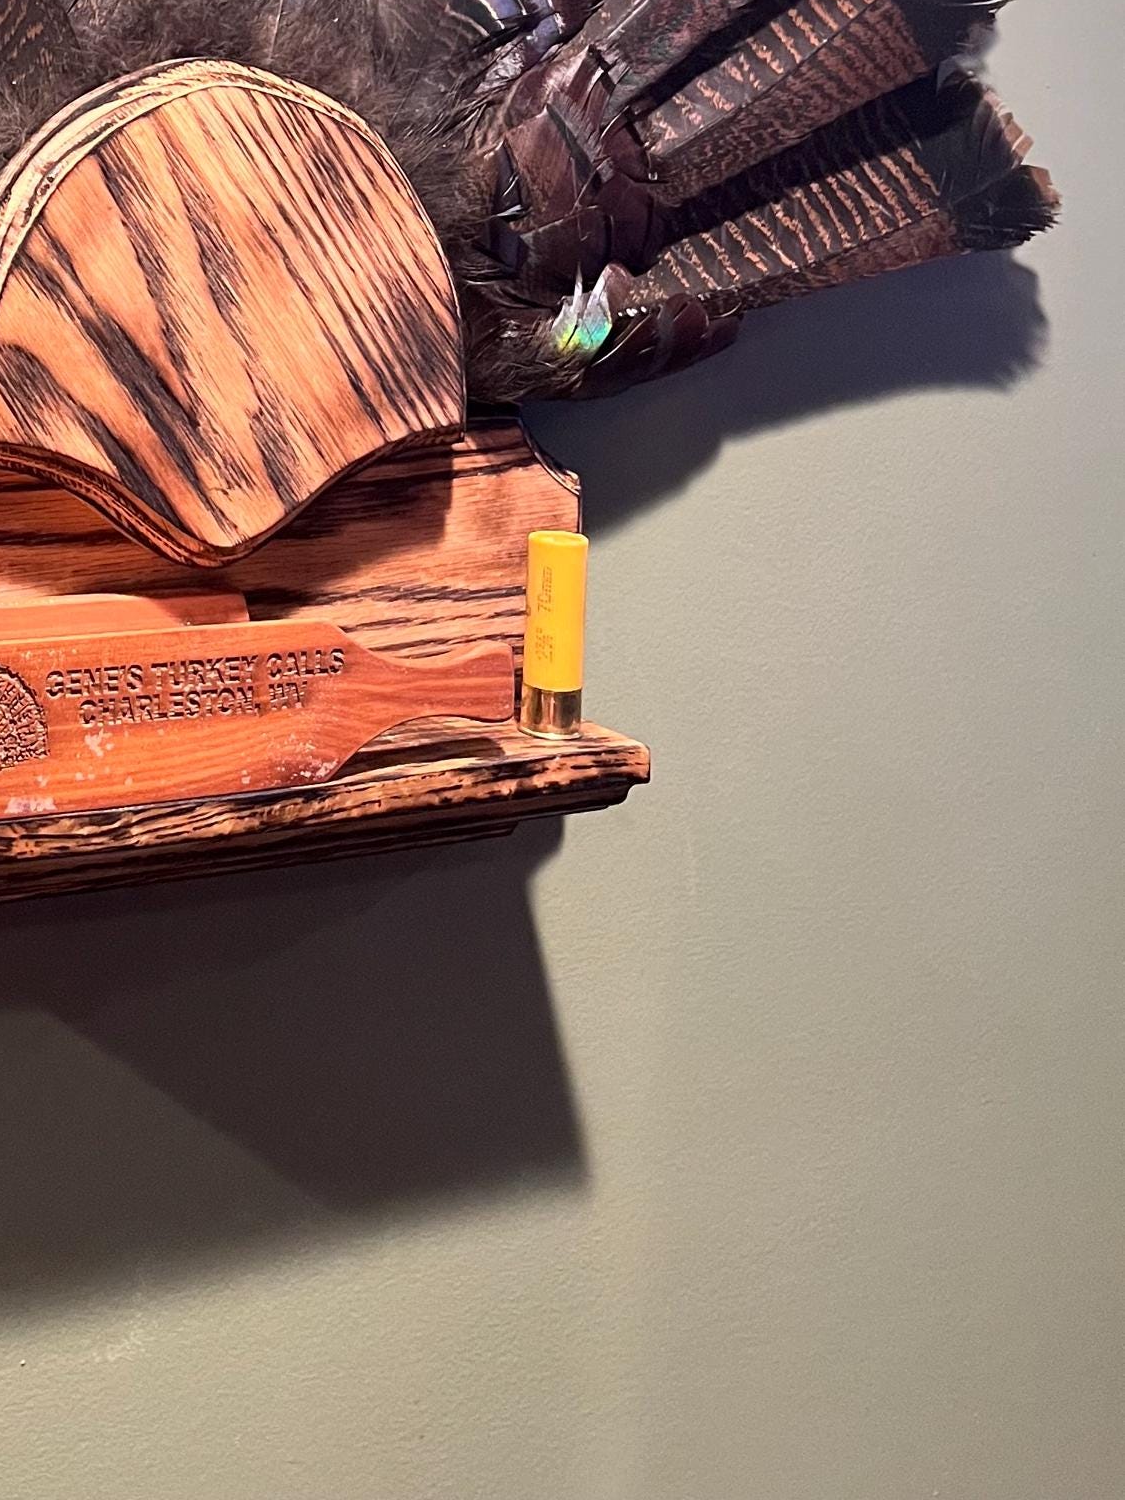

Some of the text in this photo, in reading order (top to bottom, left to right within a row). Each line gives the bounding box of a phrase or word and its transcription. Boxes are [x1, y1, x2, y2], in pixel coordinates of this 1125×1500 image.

[45, 648, 345, 699] GENE'S TURKEY CALLS
[79, 681, 308, 728] CHARLESTON, WV
